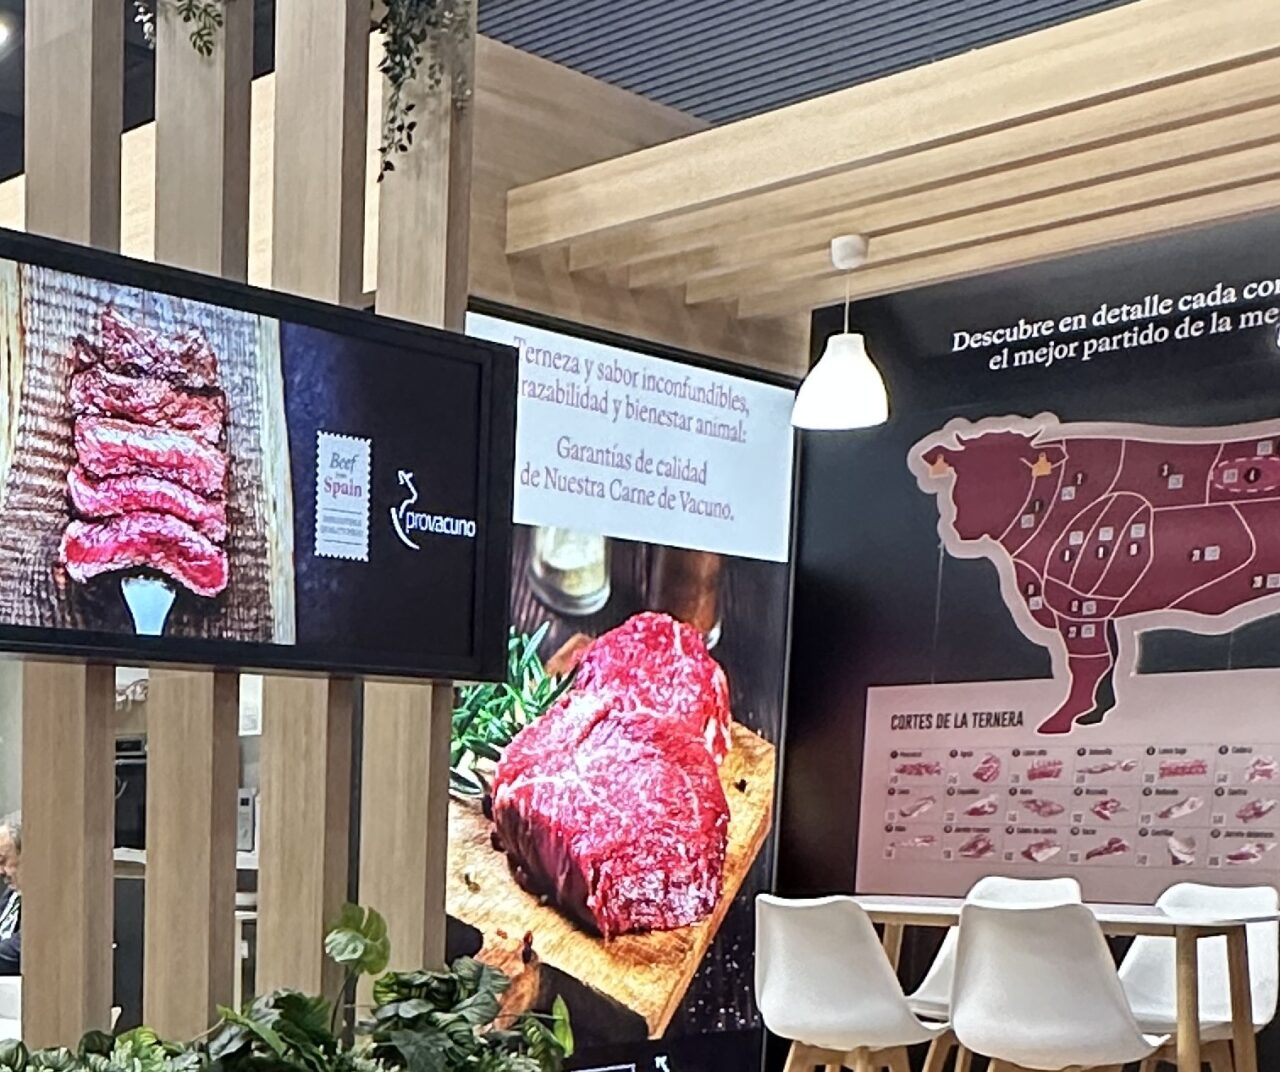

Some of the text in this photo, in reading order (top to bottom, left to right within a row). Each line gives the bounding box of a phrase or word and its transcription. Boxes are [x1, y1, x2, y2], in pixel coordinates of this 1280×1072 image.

[951, 319, 1054, 352] Descubre
[1058, 313, 1087, 333] en
[1092, 295, 1173, 328] detalle
[1178, 282, 1237, 312] cada
[988, 348, 1008, 370] el
[1013, 340, 1079, 367] mejor
[1082, 323, 1169, 361] partido
[1174, 315, 1204, 340] de
[1209, 311, 1232, 334] la
[520, 378, 608, 414] razabilidad
[612, 398, 622, 423] y
[625, 394, 693, 435] bienestar
[584, 358, 594, 384] y
[597, 358, 639, 387] sabor
[641, 367, 750, 418] inconfundibles,
[324, 475, 363, 499] Spain
[329, 452, 360, 475] Beef
[556, 435, 708, 486] Garantías de calidad
[520, 462, 735, 521] de Nuestra Carne de Vacuno.
[405, 510, 477, 537] provacuno
[890, 711, 1024, 730] CORTES DE LA TERNERA
